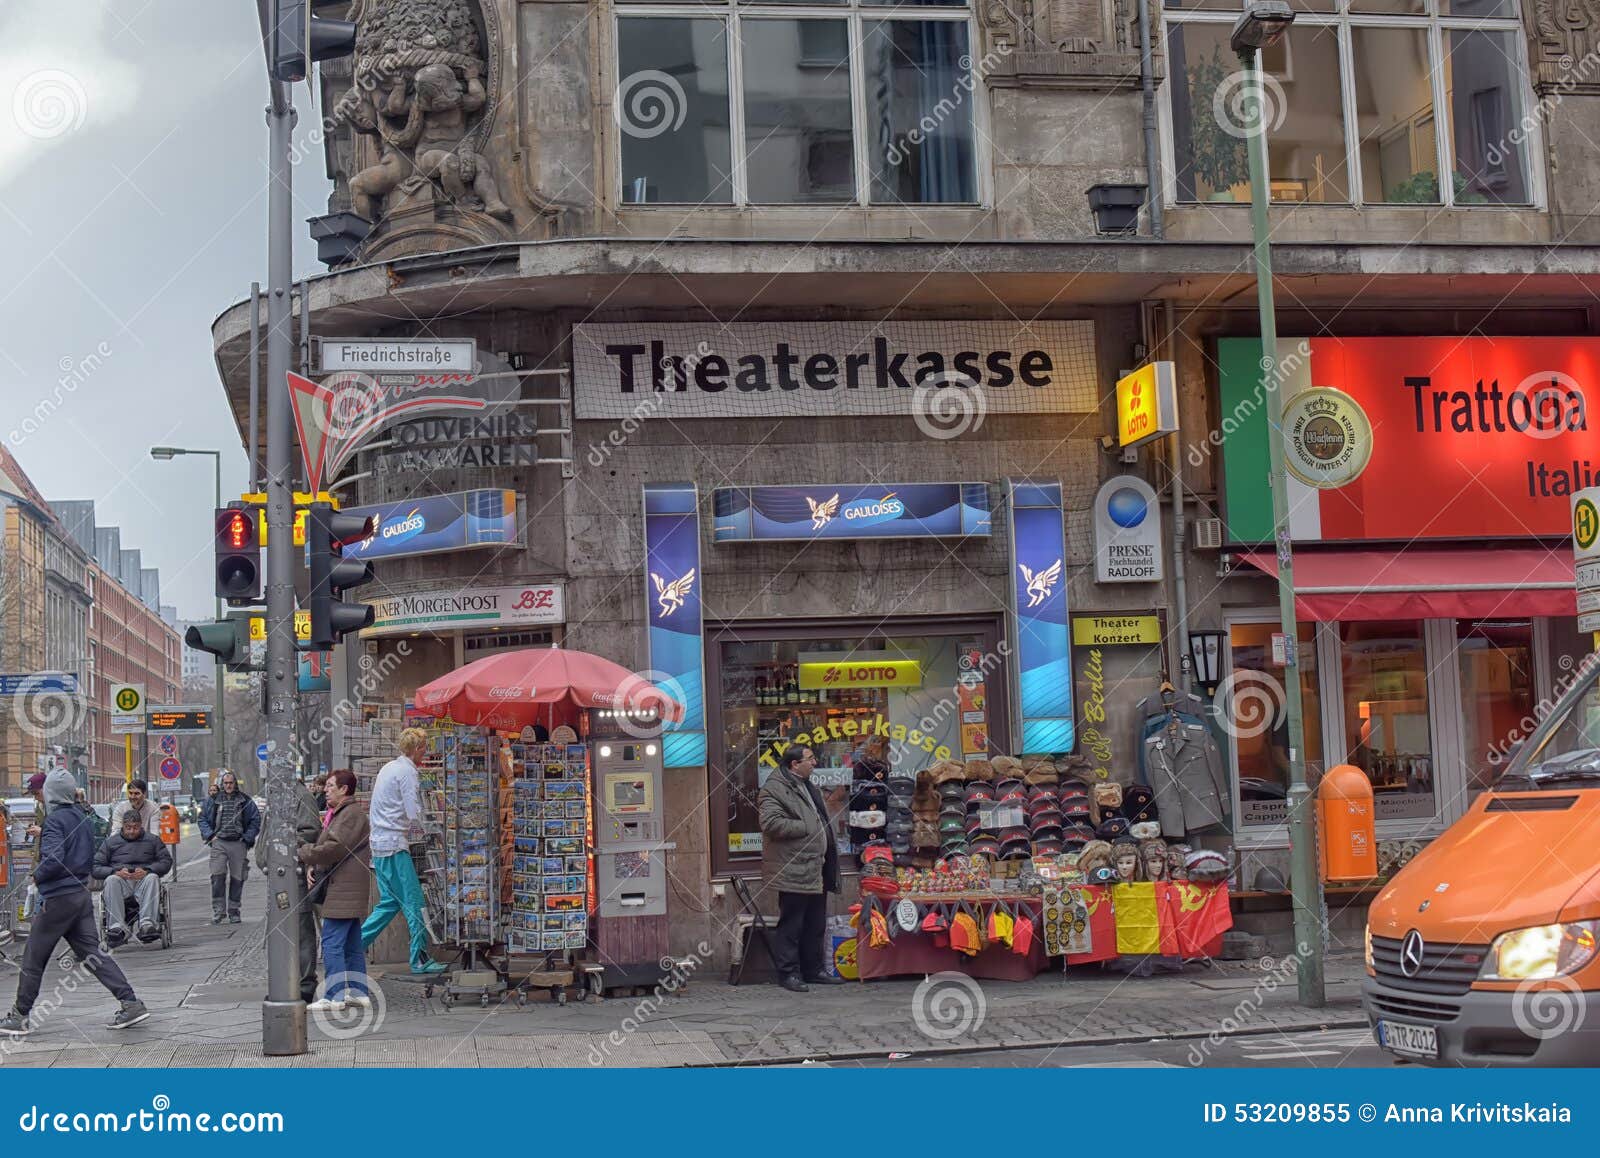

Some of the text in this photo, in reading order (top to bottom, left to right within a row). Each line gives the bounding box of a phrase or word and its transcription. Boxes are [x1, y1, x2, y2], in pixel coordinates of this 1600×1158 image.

[341, 346, 452, 364] Friedrichstraße
[605, 337, 1054, 393] Theaterkasse
[1403, 376, 1588, 433] Trattoria
[1127, 412, 1148, 436] LOTTO
[844, 502, 901, 520] GAULOISES
[382, 516, 424, 539] GAULOISES
[1108, 544, 1155, 557] PRESSE
[1108, 557, 1154, 566] Fachhandel
[1108, 567, 1156, 577] RADLOFF
[402, 594, 500, 615] MORGENPOST
[1093, 618, 1140, 629] Theater
[1093, 632, 1142, 644] Konzert
[848, 667, 897, 682] LOTTO
[1083, 648, 1106, 723] Berlin
[758, 714, 953, 769] Theaterkasse
[1409, 1028, 1436, 1051] 2012
